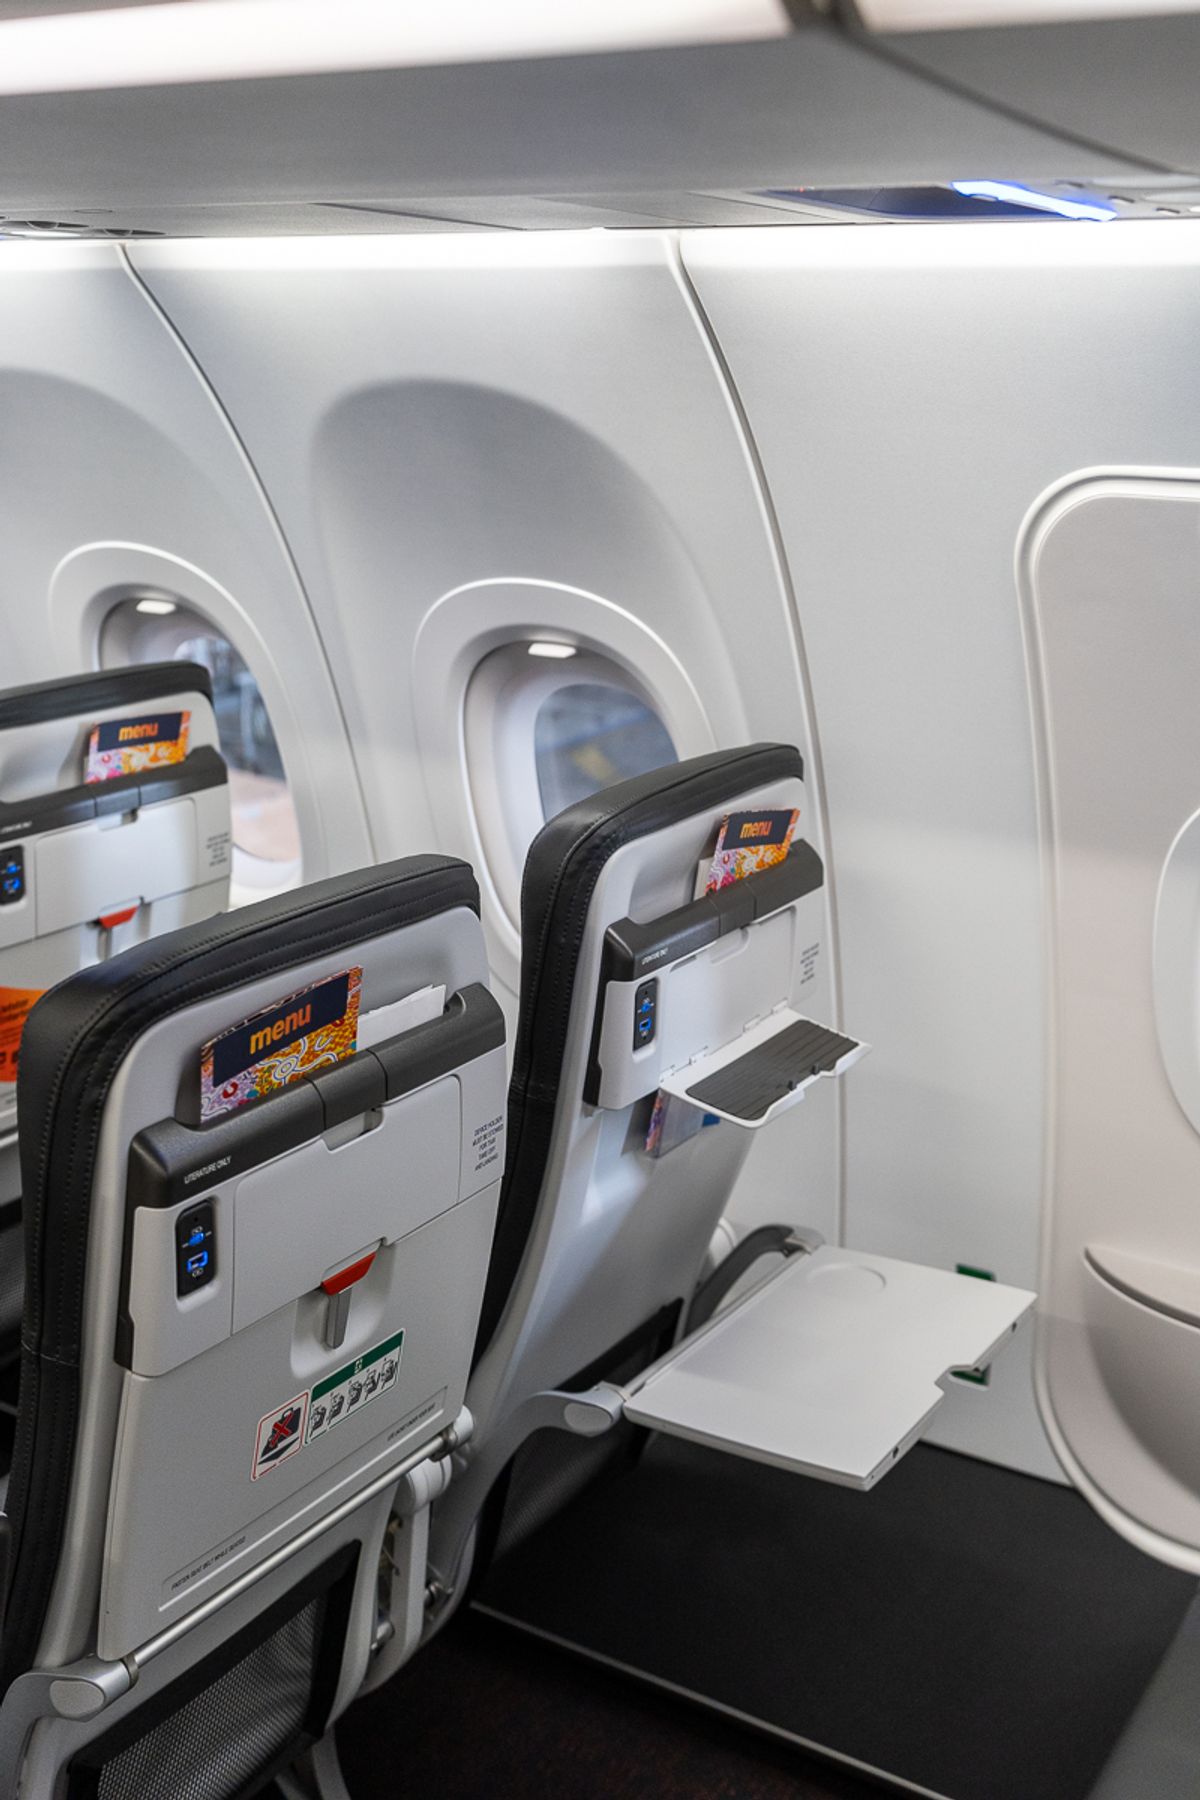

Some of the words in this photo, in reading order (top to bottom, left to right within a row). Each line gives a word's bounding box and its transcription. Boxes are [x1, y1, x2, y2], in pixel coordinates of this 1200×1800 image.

[118, 722, 159, 742] menu
[739, 820, 773, 839] menu
[249, 1003, 312, 1055] menu
[184, 1162, 217, 1184] LITERATURE
[216, 1155, 232, 1169] ONLY
